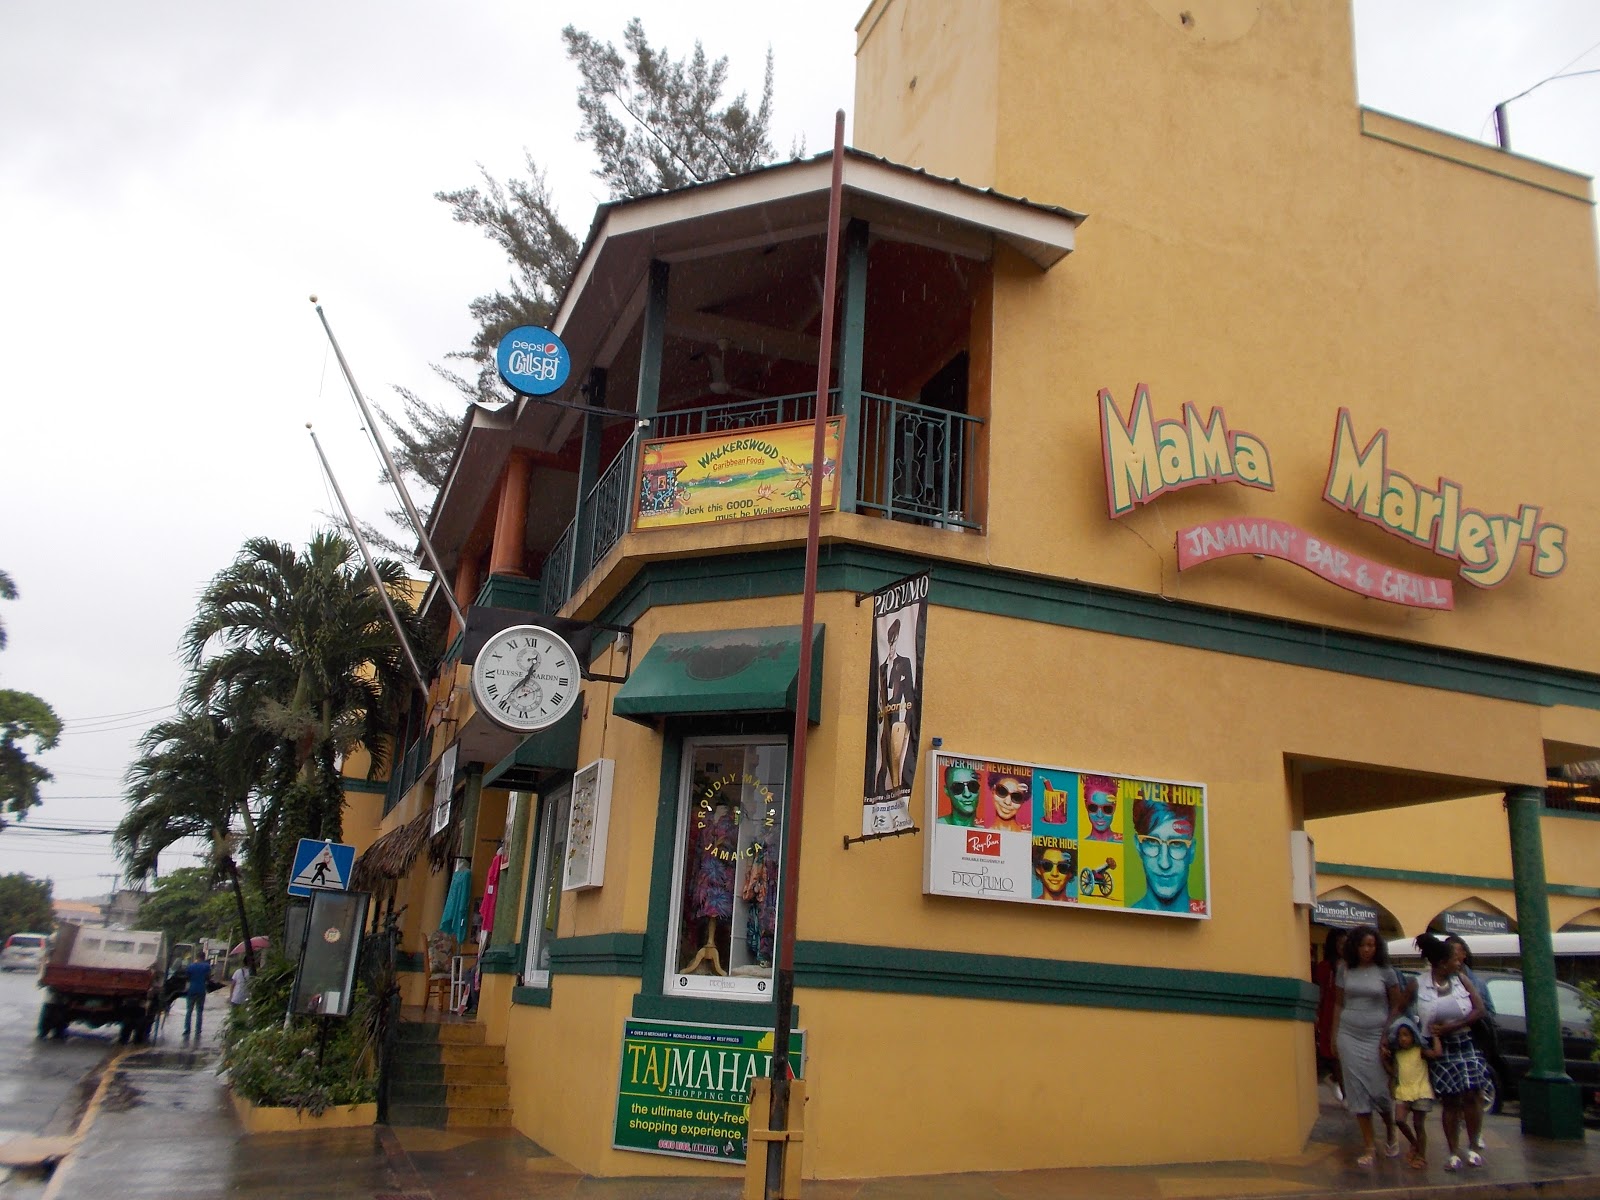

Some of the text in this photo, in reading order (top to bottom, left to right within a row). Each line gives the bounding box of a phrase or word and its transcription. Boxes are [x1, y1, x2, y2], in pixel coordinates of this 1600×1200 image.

[512, 340, 545, 353] pepsi
[697, 438, 779, 469] WALKERSWOOD
[713, 455, 765, 472] Caribbean Foods
[1323, 407, 1568, 590] Marley's
[685, 505, 705, 516] Jerk
[708, 503, 723, 513] this
[715, 512, 737, 520] must
[740, 510, 751, 518] be
[1185, 522, 1447, 607] JAMMIN' BAR & GRILL
[496, 670, 560, 682] ULYSSE NARDIN
[939, 756, 985, 771] NEVER HIDE
[986, 762, 1032, 777] NEVER HIDE
[697, 773, 736, 829] PROUDLY
[743, 773, 773, 804] MADE
[764, 810, 775, 827] IN
[1124, 780, 1170, 803] NEVER
[1172, 784, 1203, 807] HIDE
[1032, 835, 1078, 850] NEVER HIDE
[704, 842, 763, 861] JAMAICA
[952, 869, 1014, 893] PROFUMO
[1315, 904, 1349, 915] Diamond
[1350, 907, 1376, 919] Centre
[1447, 914, 1477, 925] Diamond
[1478, 917, 1506, 928] Centre
[668, 1088, 723, 1101] SHOPPING
[631, 1103, 746, 1125] the ultimate duty-free
[629, 1119, 744, 1140] shopping experience.
